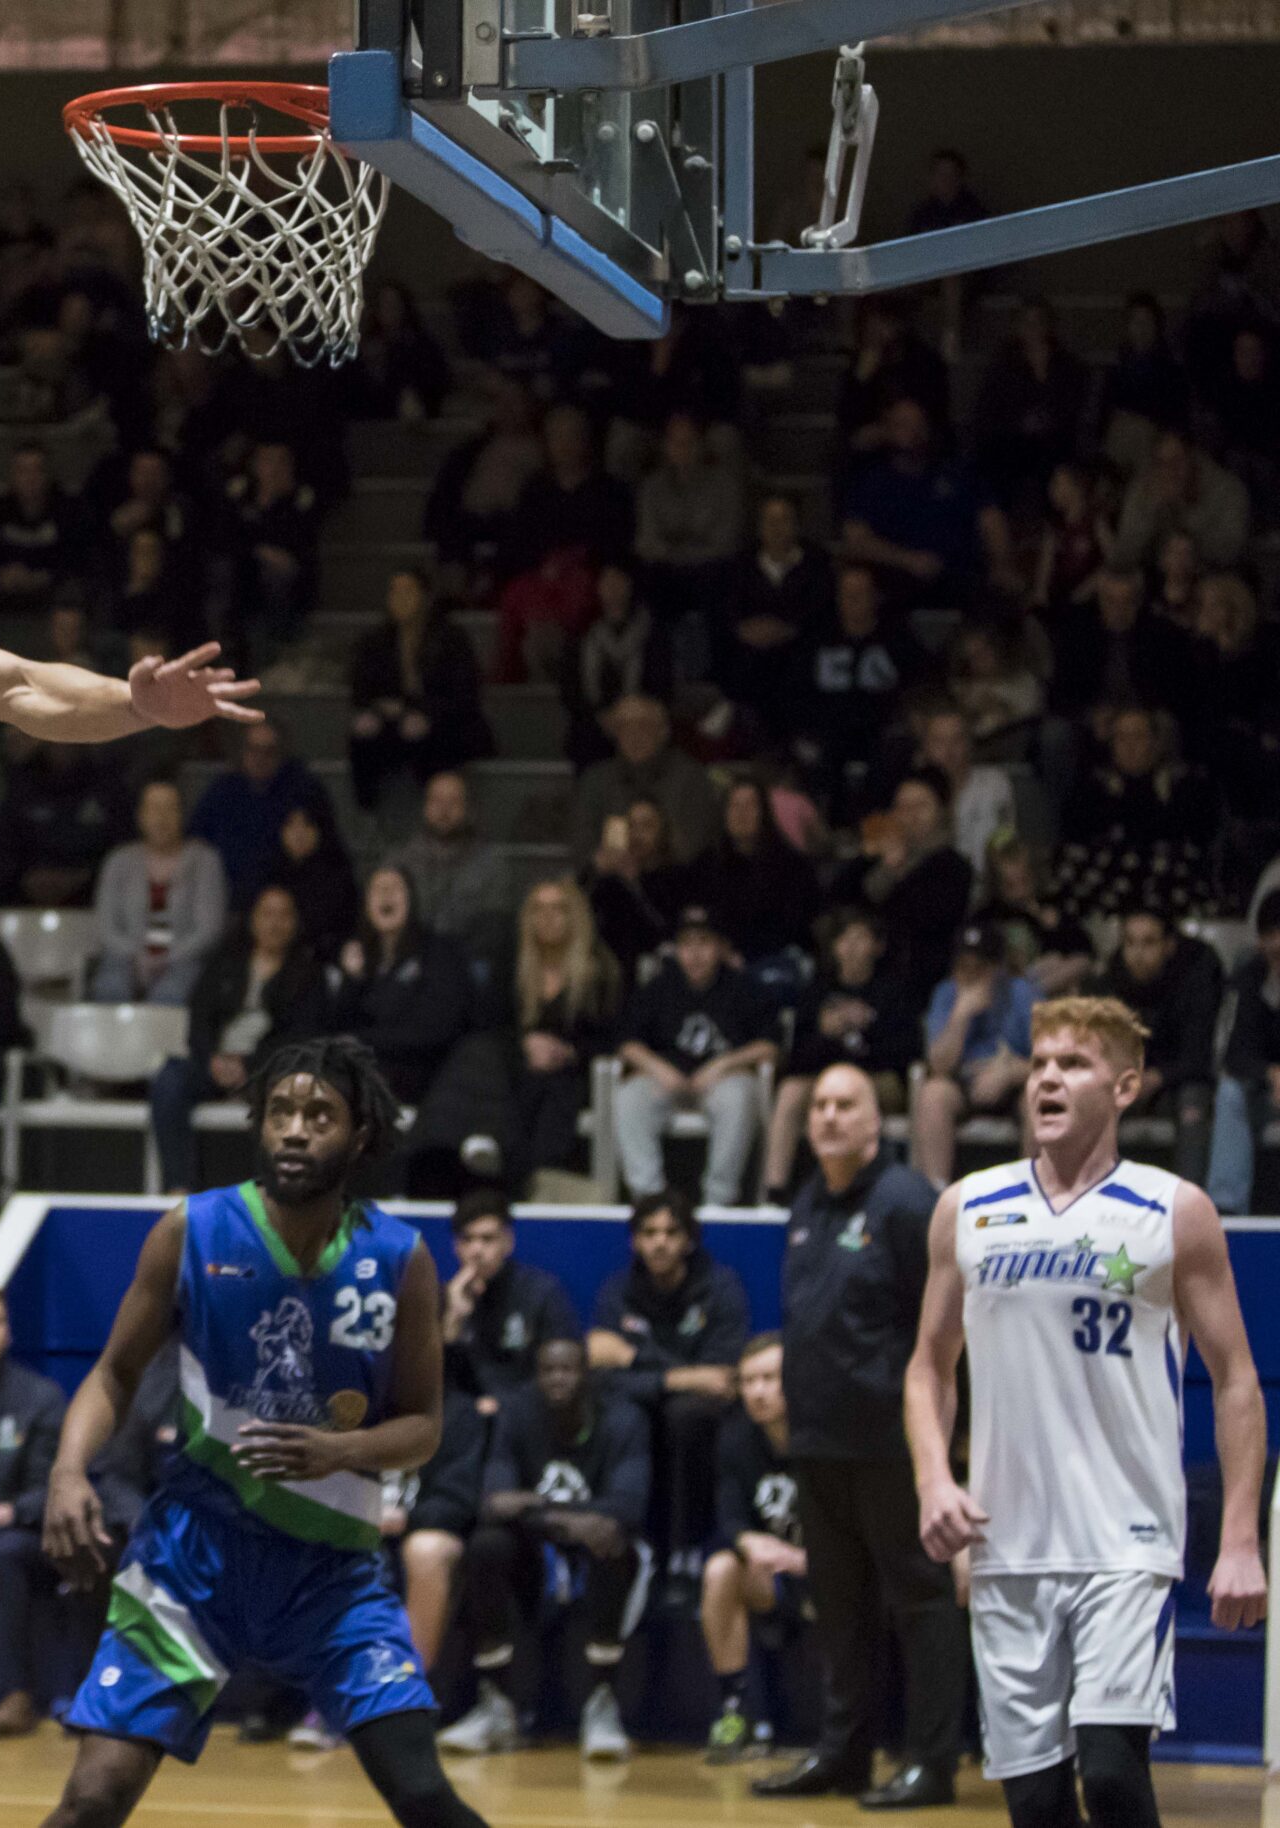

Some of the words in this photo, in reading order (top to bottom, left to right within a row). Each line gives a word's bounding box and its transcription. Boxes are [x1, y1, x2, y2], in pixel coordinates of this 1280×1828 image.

[977, 1248, 1103, 1286] MAGIC
[329, 1286, 398, 1352] 23
[1071, 1295, 1134, 1359] 32
